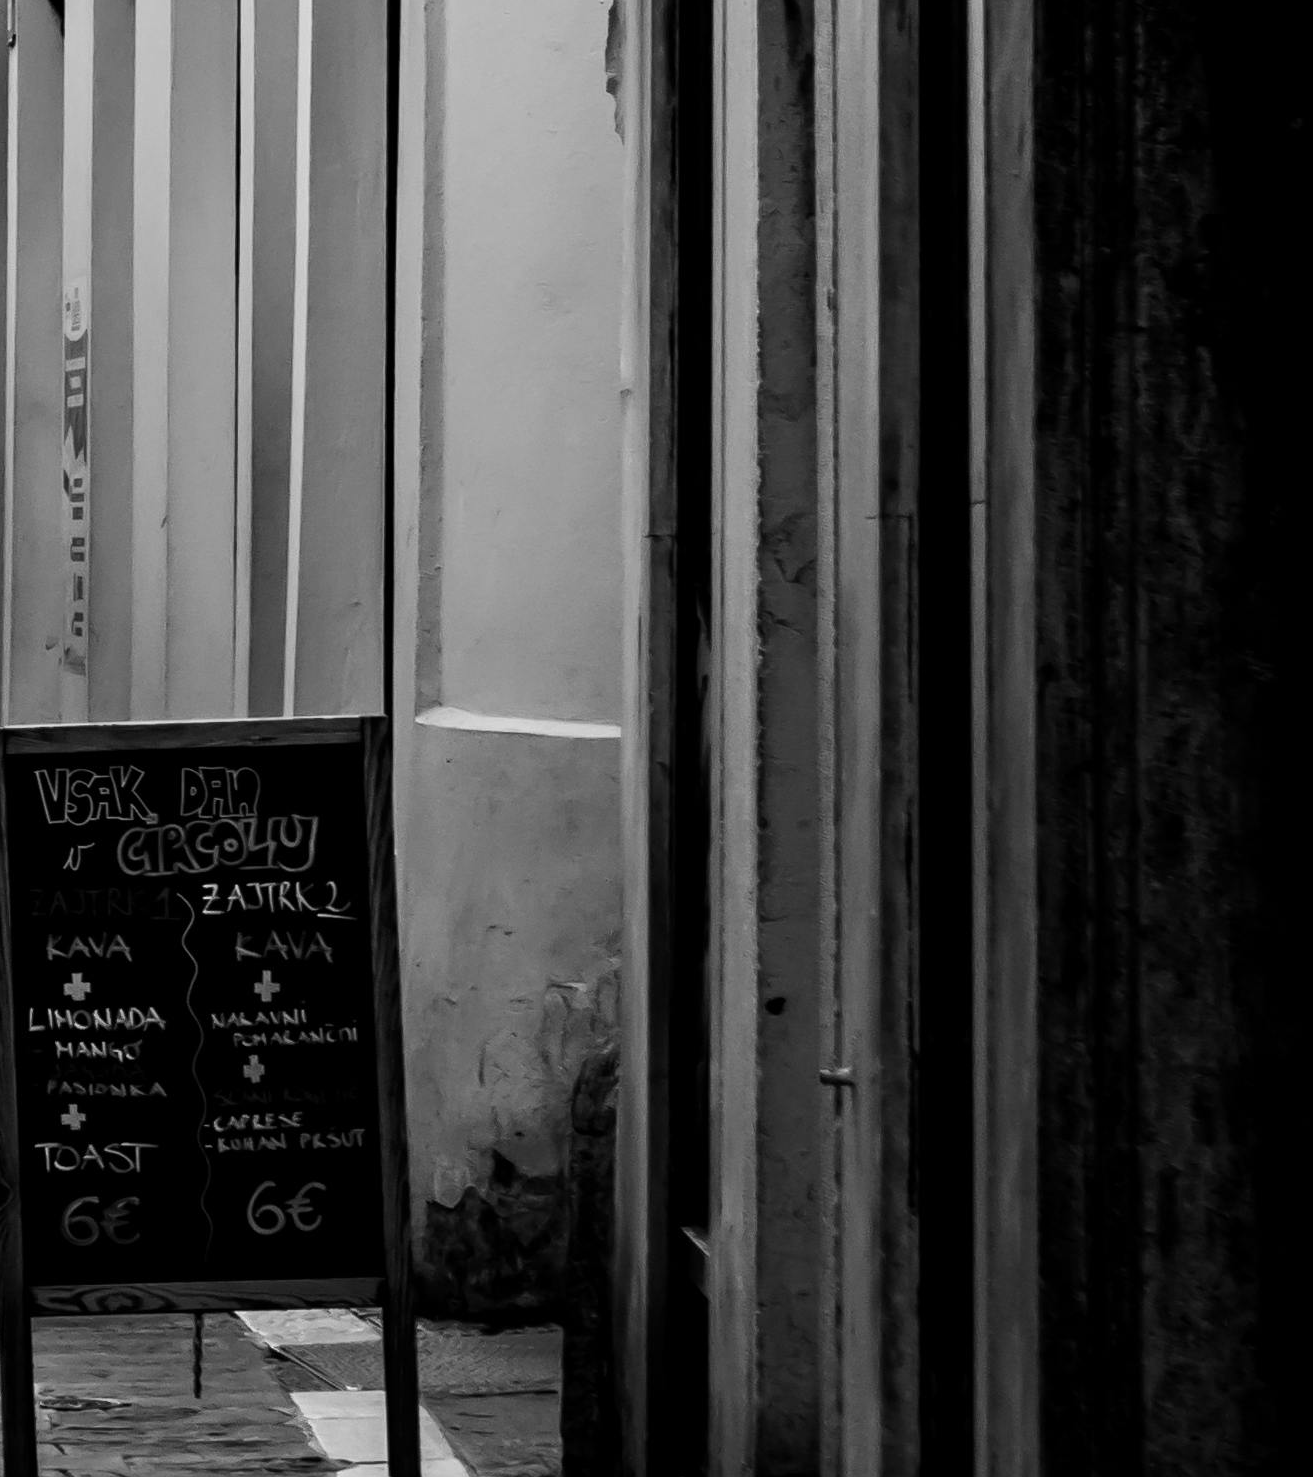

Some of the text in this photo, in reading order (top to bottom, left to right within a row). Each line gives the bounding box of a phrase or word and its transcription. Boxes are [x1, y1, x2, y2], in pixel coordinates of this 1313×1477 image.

[45, 931, 134, 964] KAVA
[234, 929, 336, 965] KAVA
[27, 1006, 167, 1032] LIMONADA
[54, 1039, 143, 1063] MANGO
[33, 1141, 161, 1174] TOAST
